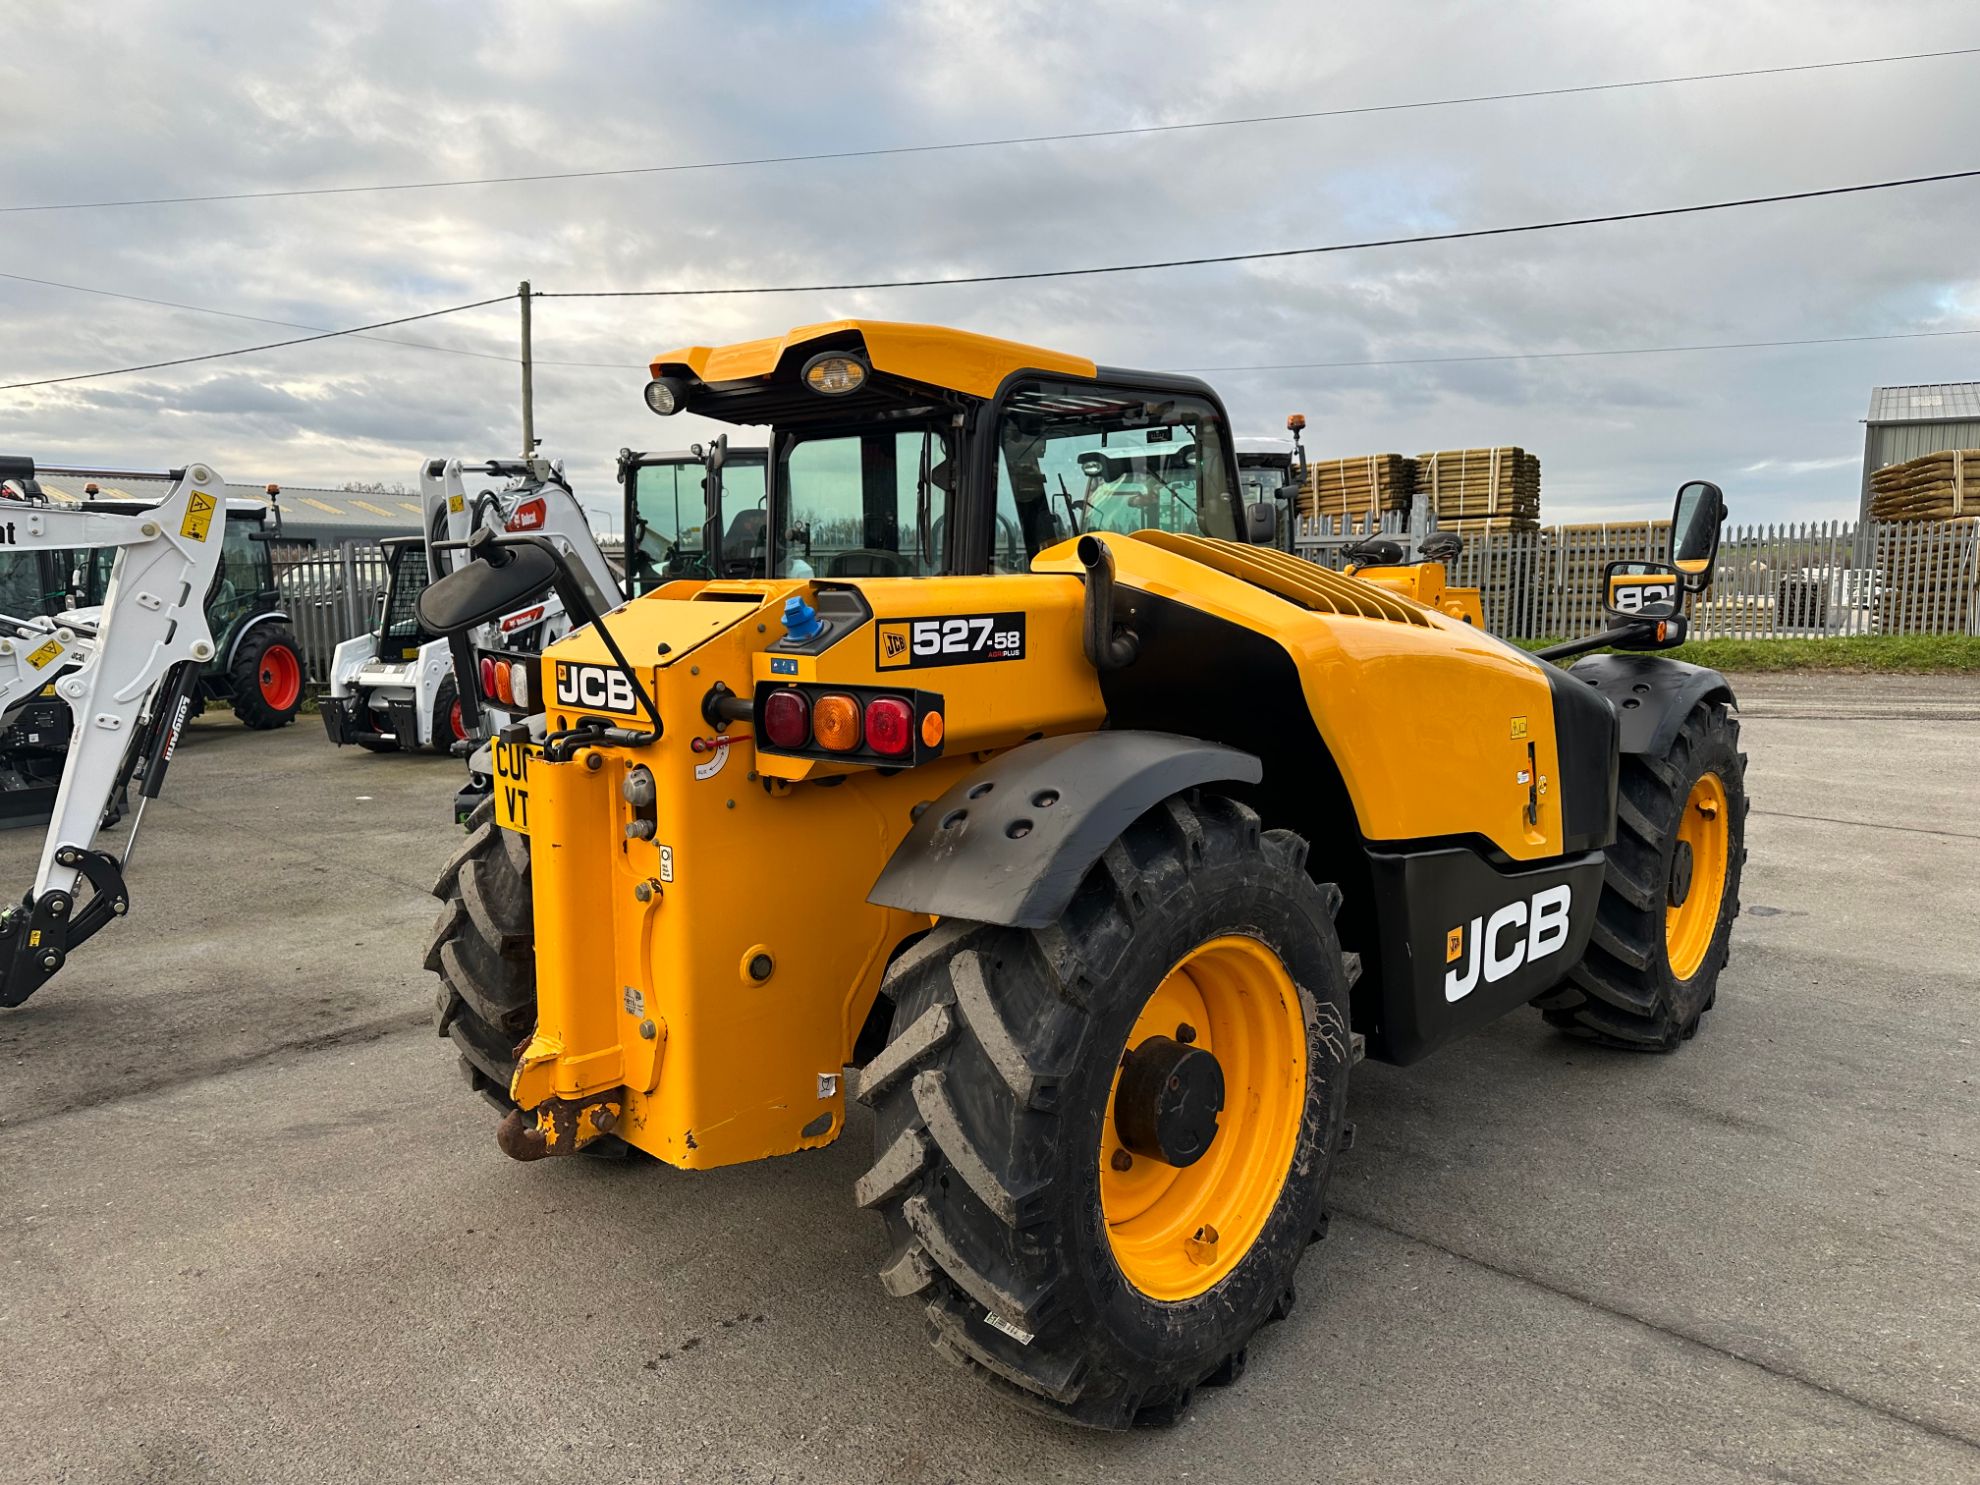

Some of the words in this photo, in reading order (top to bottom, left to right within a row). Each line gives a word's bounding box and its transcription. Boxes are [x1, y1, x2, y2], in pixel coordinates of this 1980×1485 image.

[887, 634, 906, 655] JCB
[988, 649, 1021, 658] AGRIPLUS
[558, 666, 636, 711] JCB
[163, 694, 191, 761] LongArm
[1445, 884, 1572, 1003] JCB
